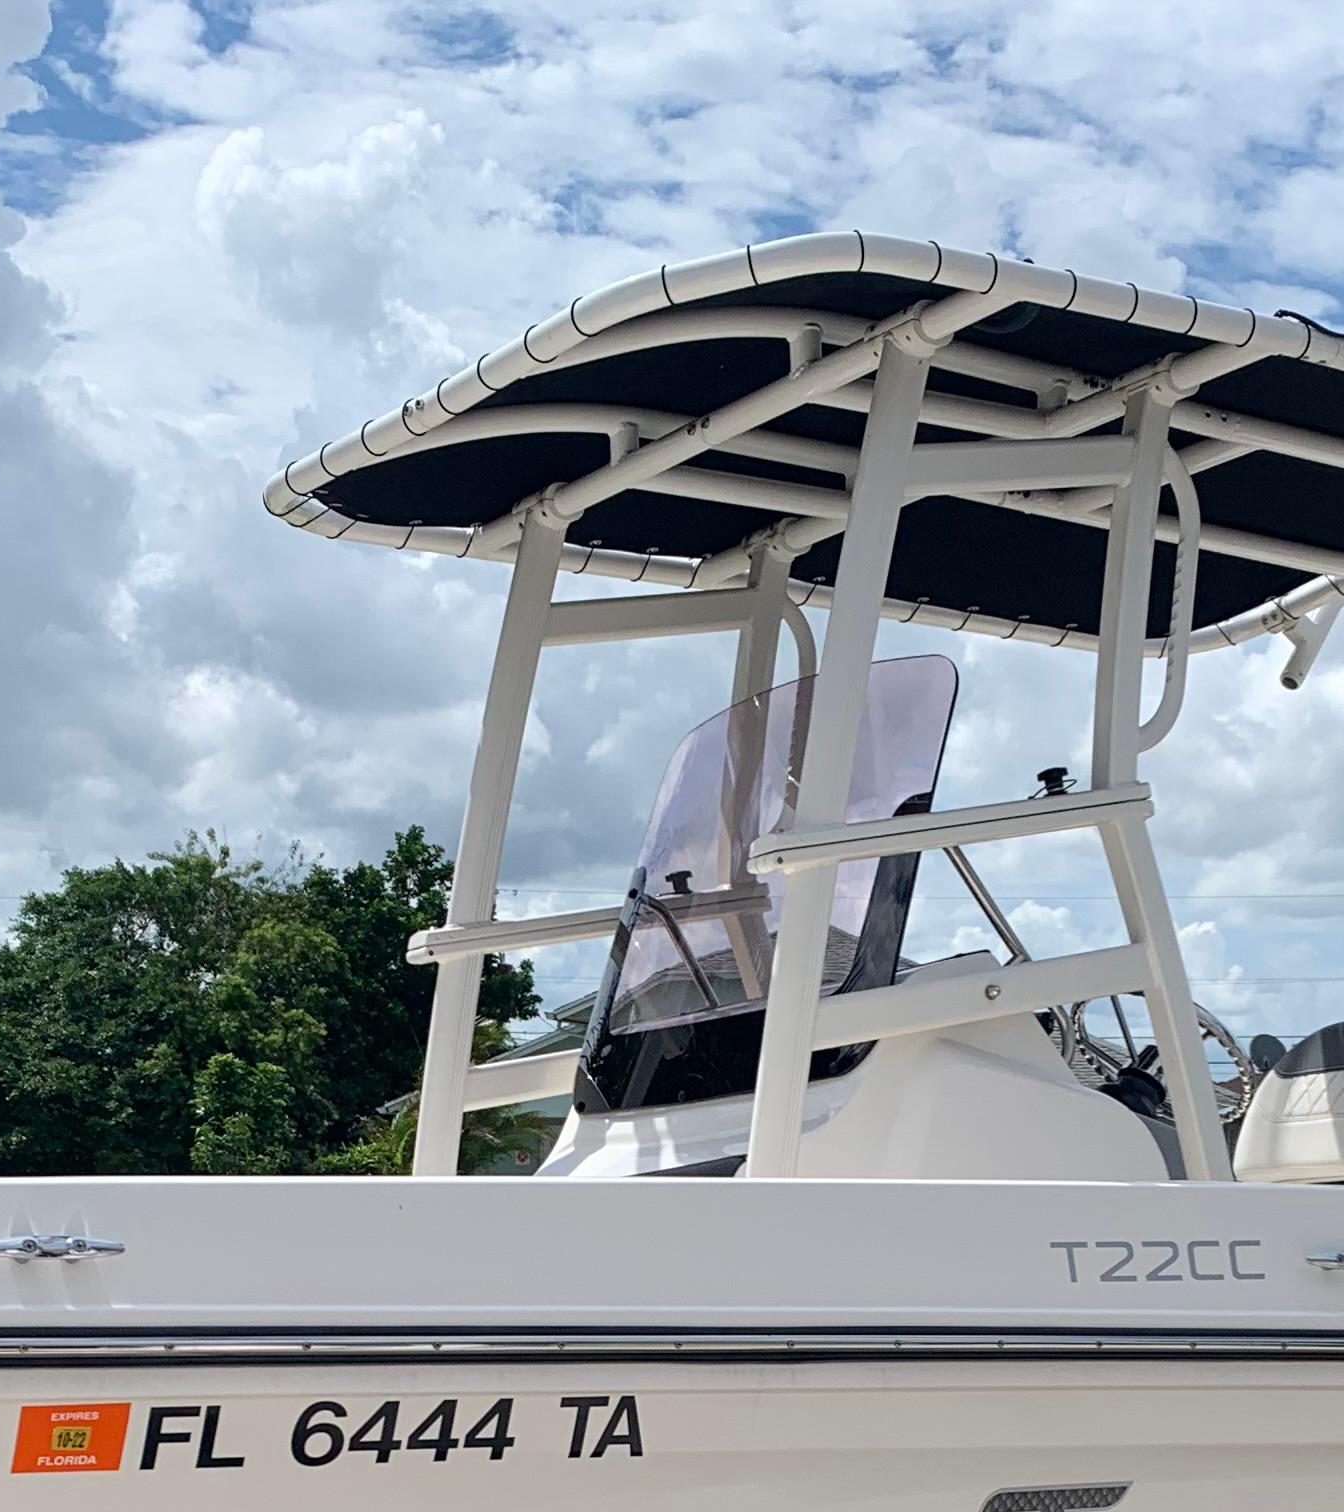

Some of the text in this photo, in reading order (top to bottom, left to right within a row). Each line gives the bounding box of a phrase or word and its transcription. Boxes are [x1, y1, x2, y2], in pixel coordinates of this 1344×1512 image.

[1049, 1239, 1266, 1283] T22CC
[50, 1411, 99, 1421] EXPIRES
[56, 1431, 87, 1448] 10-22
[139, 1395, 644, 1470] FL 6444 TA
[37, 1455, 97, 1466] FLORIDA
